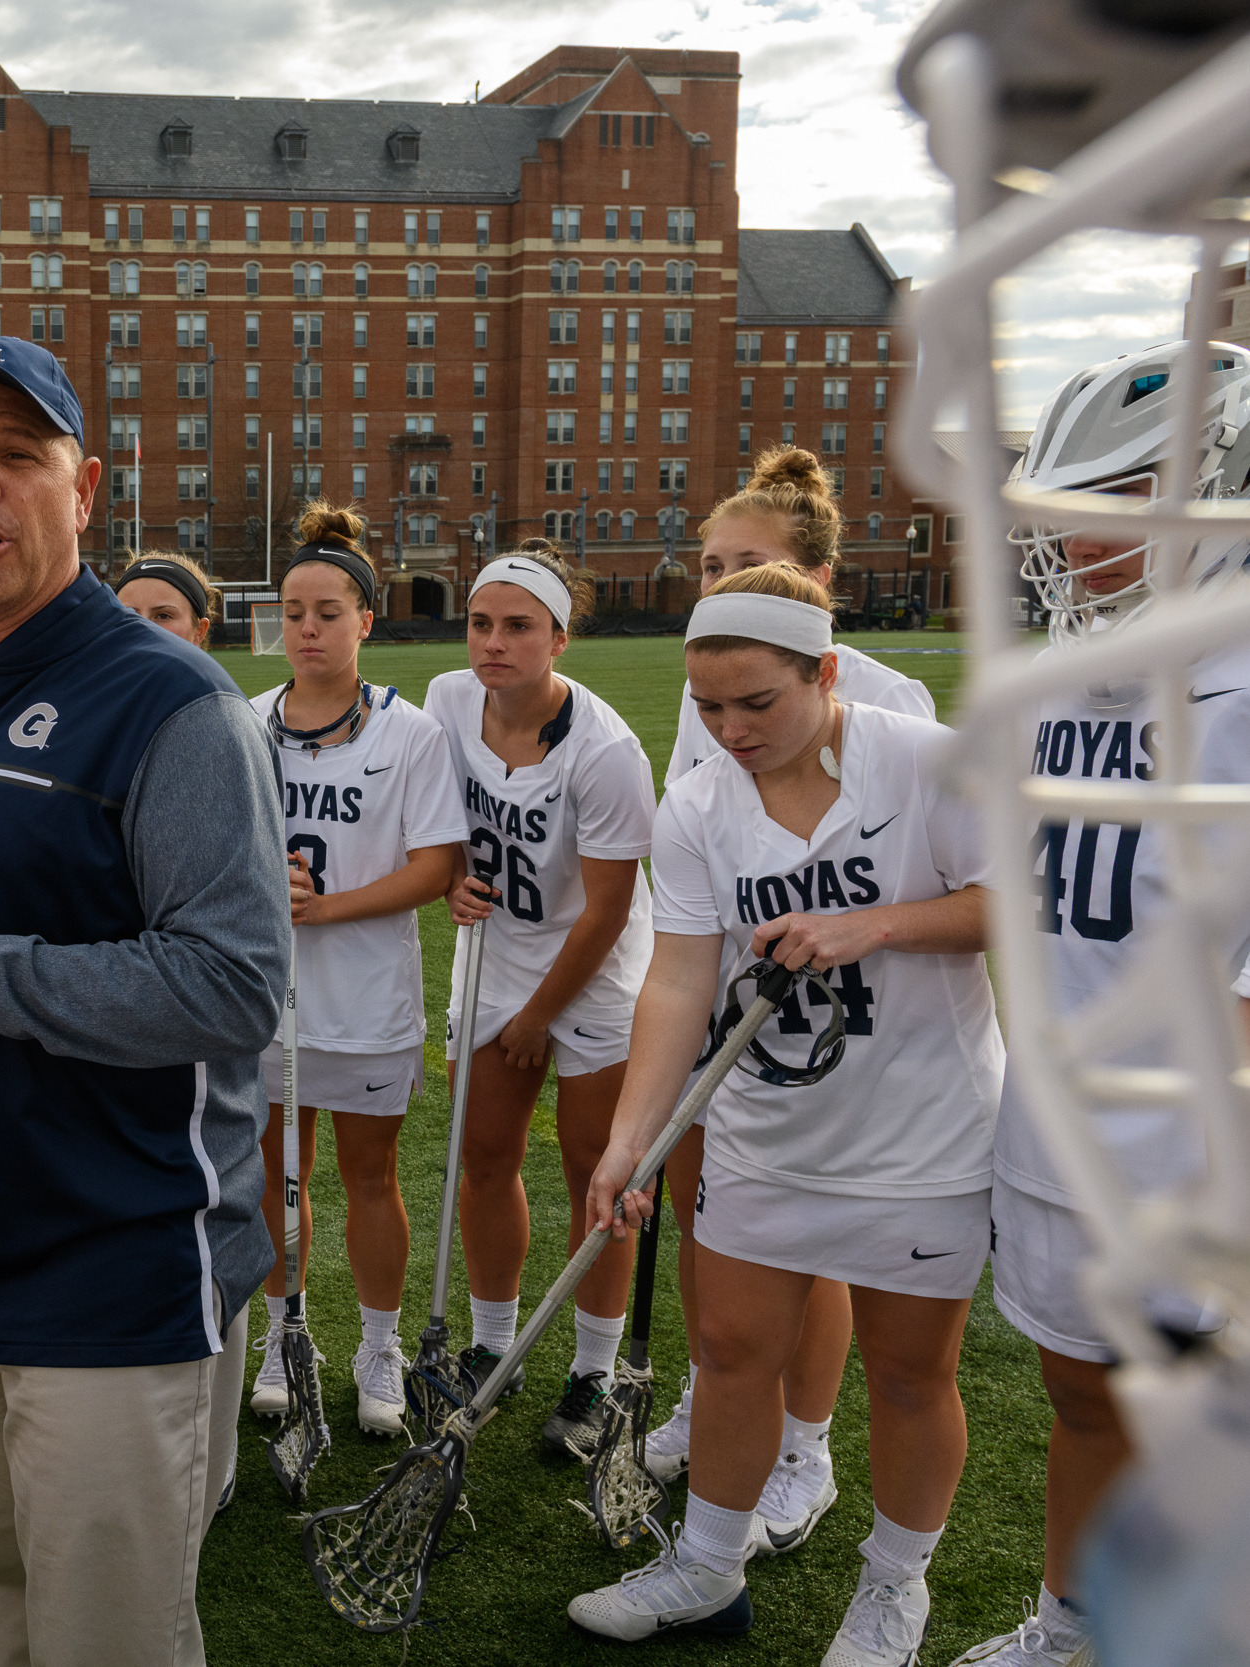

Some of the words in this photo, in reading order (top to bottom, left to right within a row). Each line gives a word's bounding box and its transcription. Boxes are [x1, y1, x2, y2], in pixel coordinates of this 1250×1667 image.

[1096, 605, 1118, 614] STX
[8, 702, 59, 750] G
[1031, 720, 1163, 781] HOYAS
[285, 782, 363, 824] OYAS
[466, 776, 547, 843] HOYAS
[470, 827, 544, 923] 26
[737, 856, 881, 924] HOYAS
[1033, 815, 1143, 942] 40
